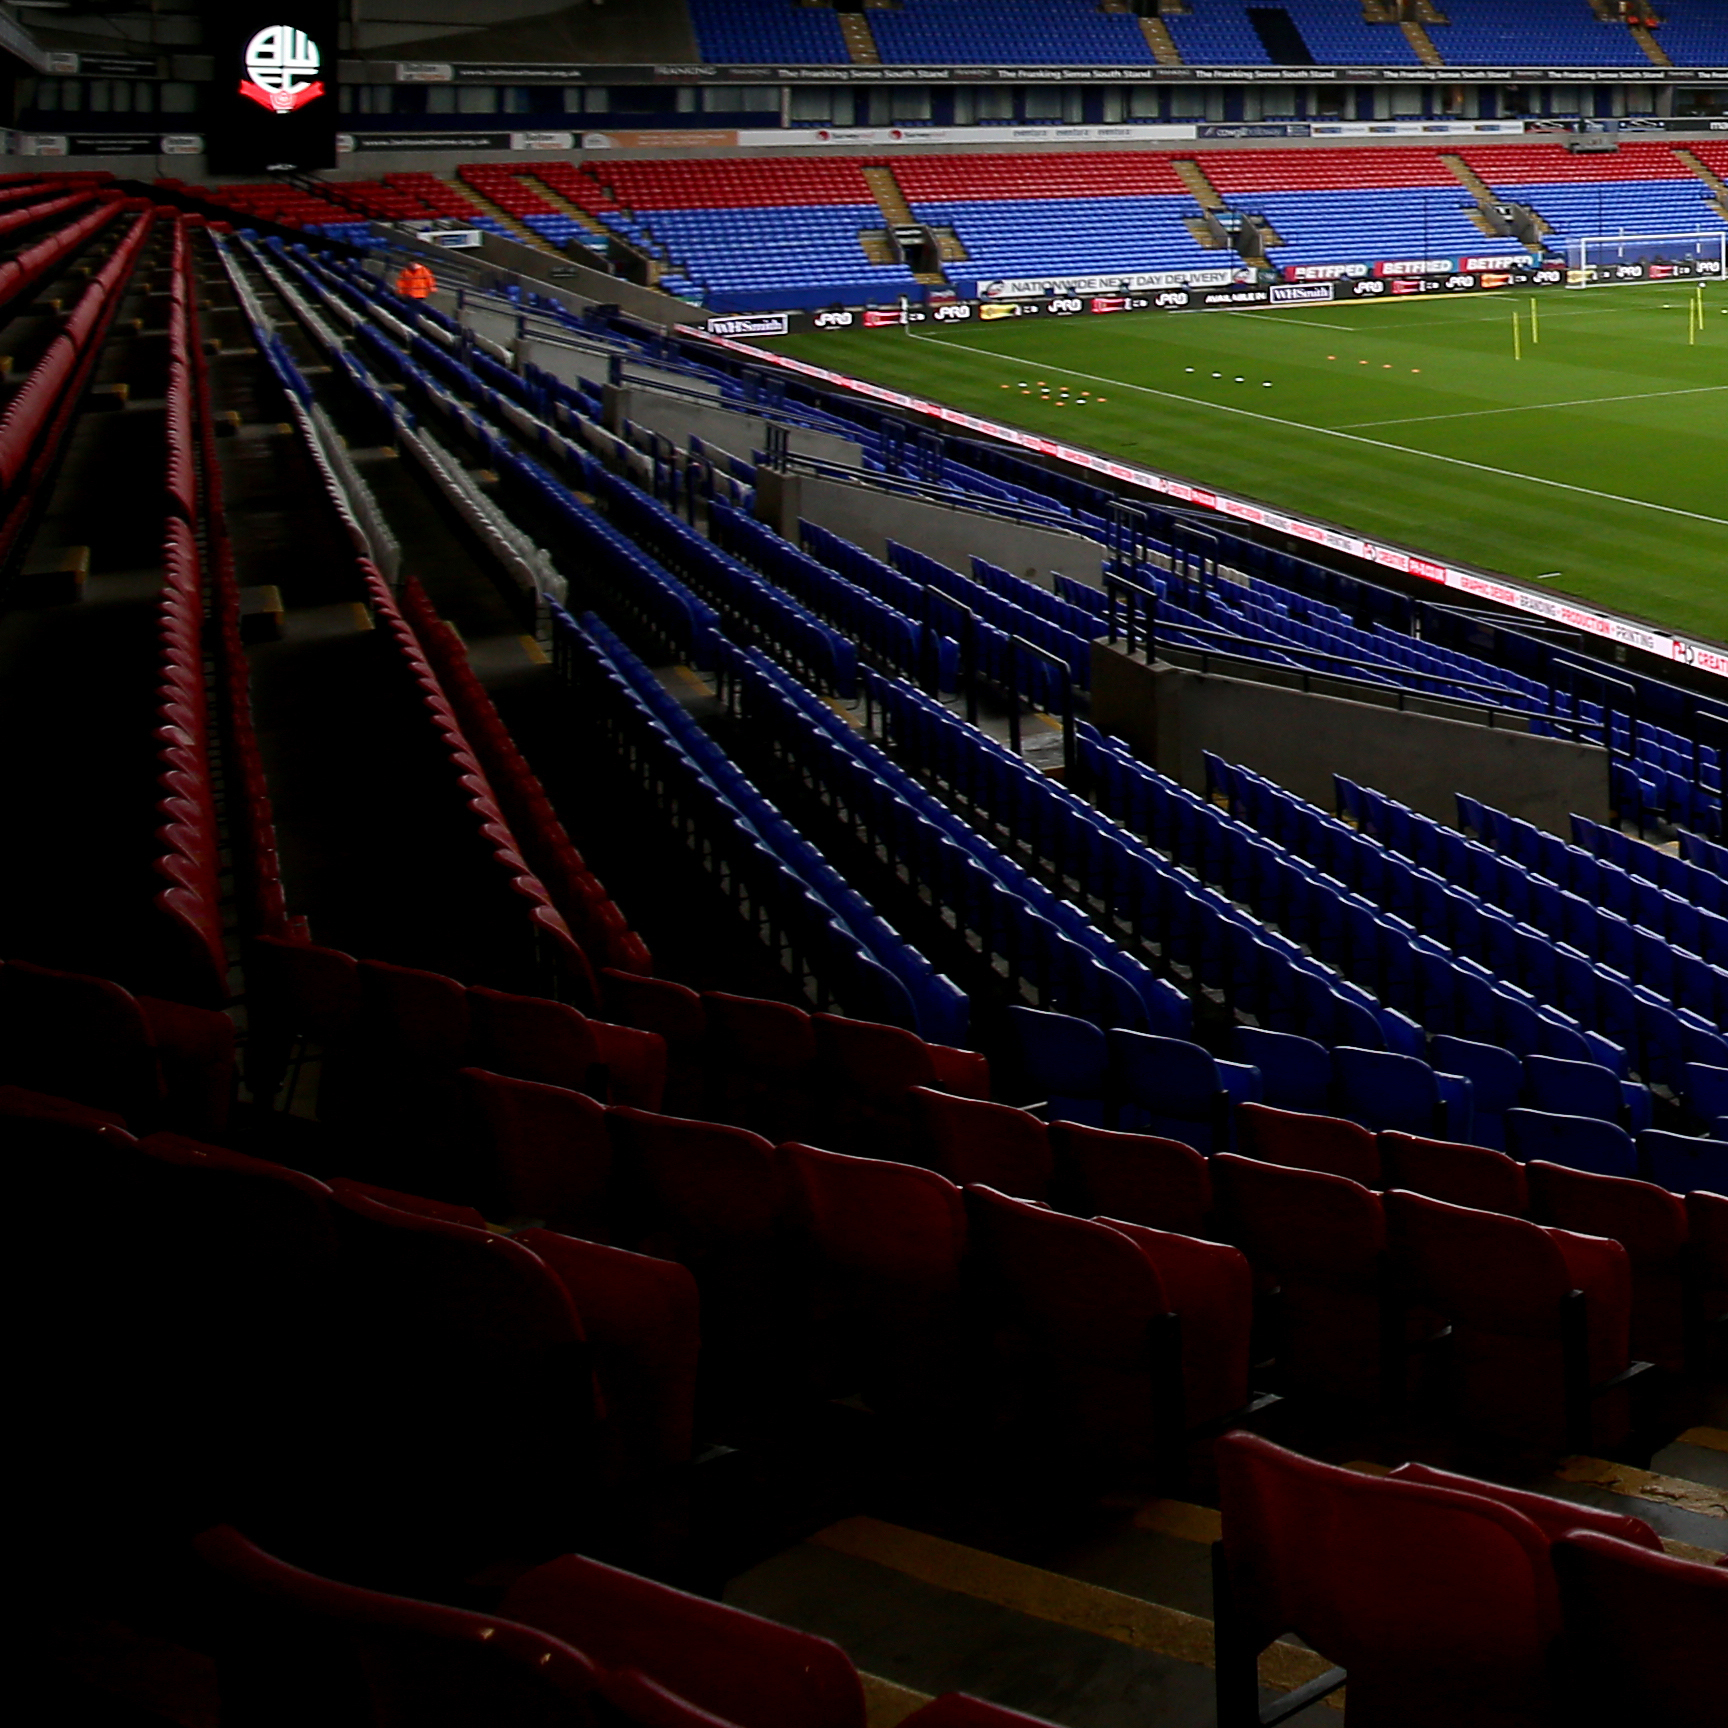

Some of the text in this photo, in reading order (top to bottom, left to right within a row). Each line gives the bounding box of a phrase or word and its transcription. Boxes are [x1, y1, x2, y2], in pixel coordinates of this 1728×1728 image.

[778, 69, 799, 79] The
[800, 69, 848, 80] Franking
[849, 69, 883, 79] Sense
[883, 69, 915, 79] South
[916, 69, 949, 79] Stand
[998, 69, 1151, 80] The Franking Sense South Stand
[1195, 70, 1335, 80] The Franking Sense South Stand
[1295, 263, 1368, 280] BETFRED
[1382, 260, 1453, 276] BETFRED
[1011, 271, 1227, 294] NATIONWIDE NEXT DAY DELIVERY
[1274, 286, 1330, 300] WHSmith
[714, 318, 784, 334] WHSmith
[1561, 606, 1611, 634] PRODUCTION
[1616, 622, 1654, 649] PRINTING
